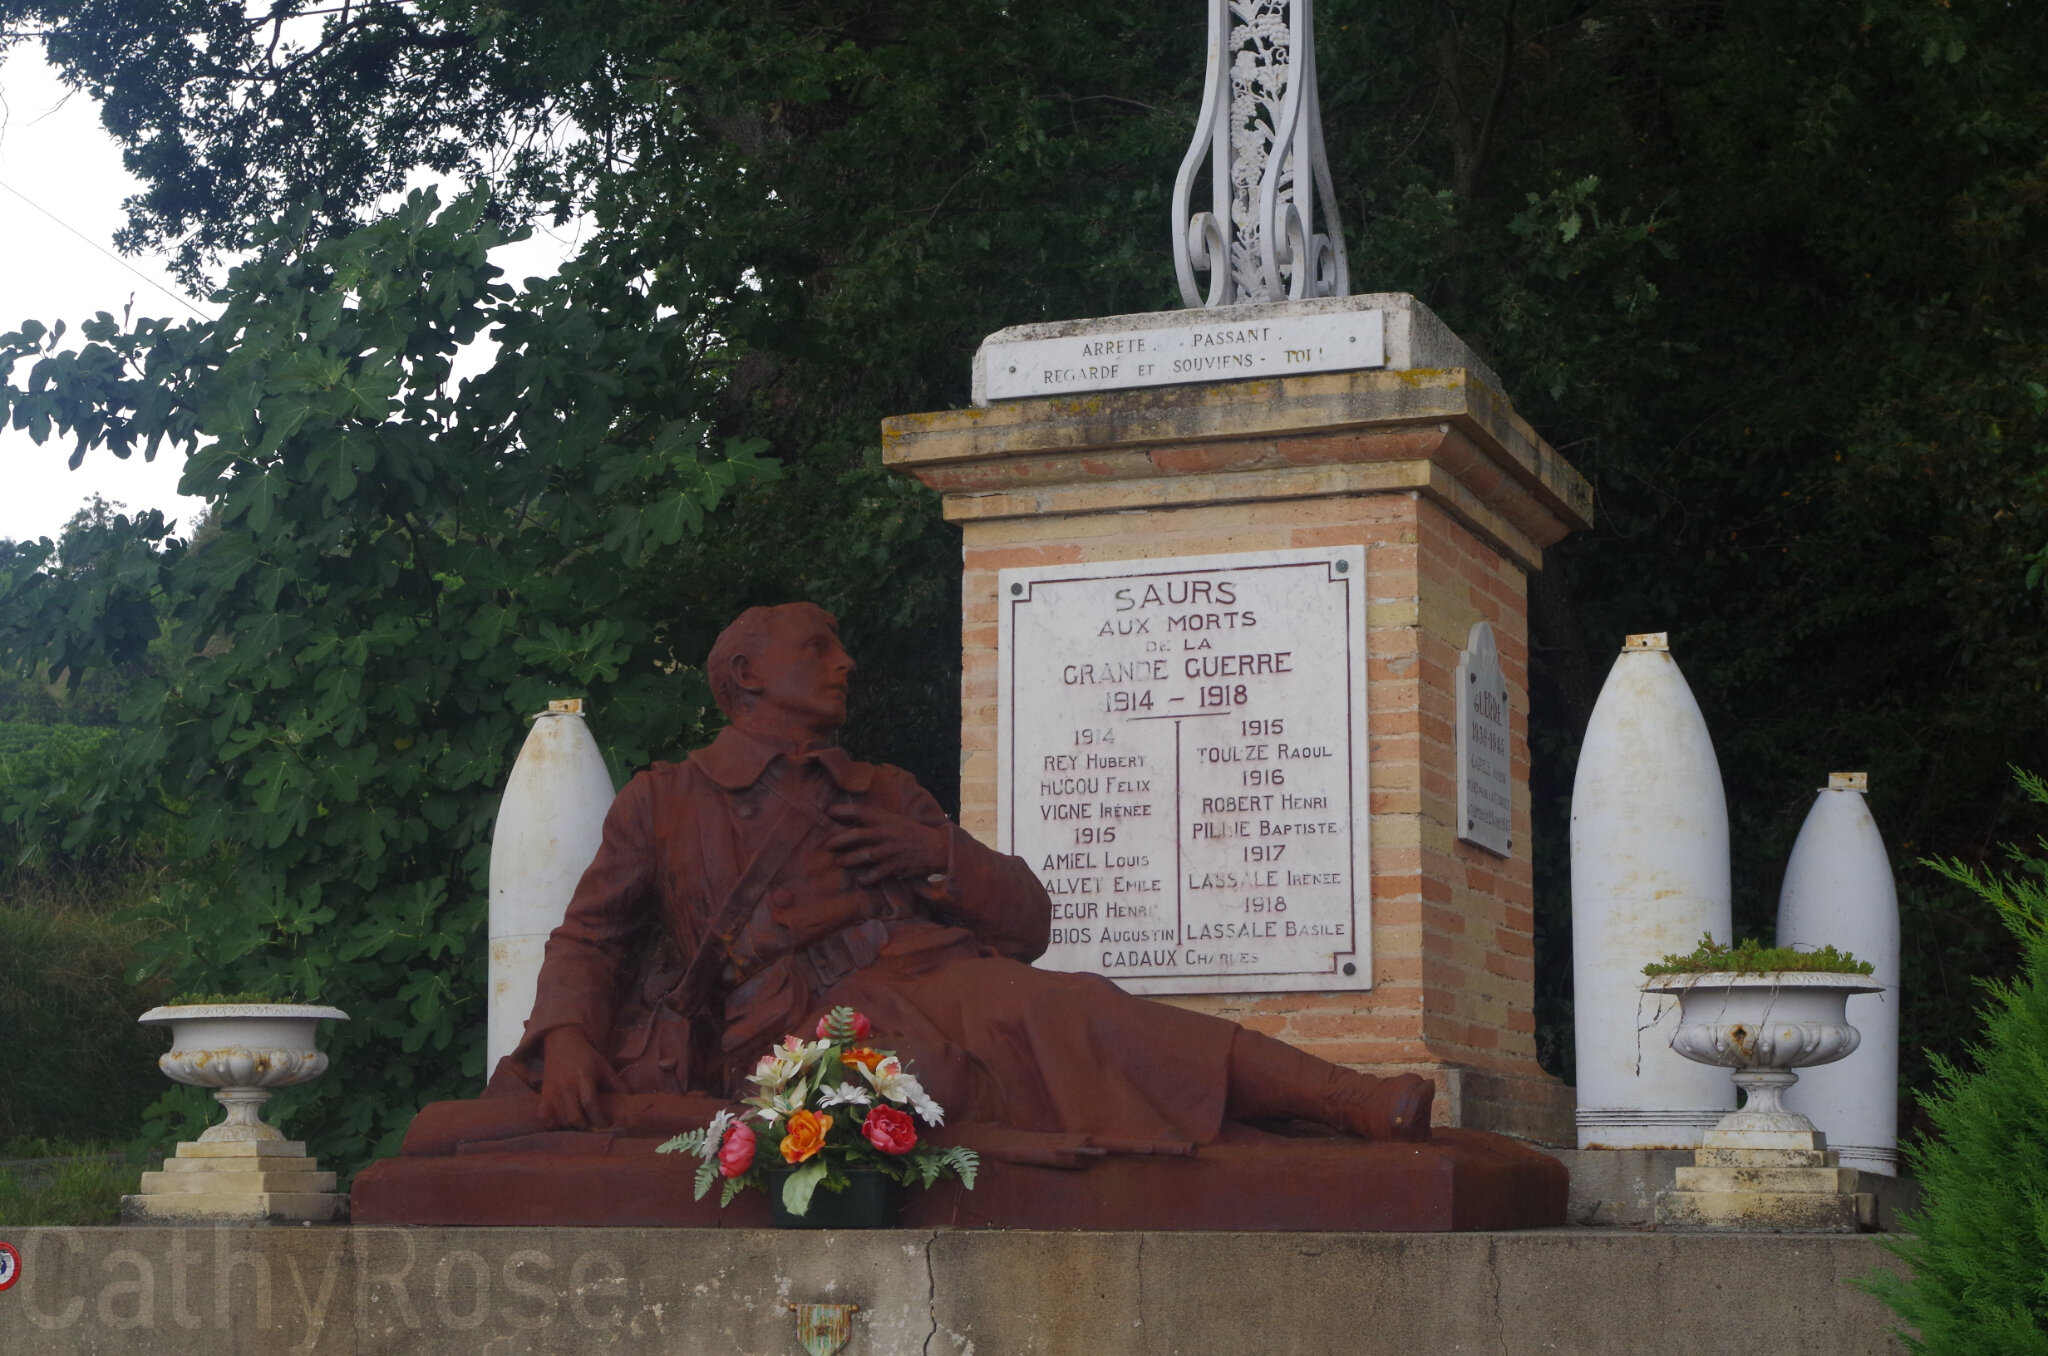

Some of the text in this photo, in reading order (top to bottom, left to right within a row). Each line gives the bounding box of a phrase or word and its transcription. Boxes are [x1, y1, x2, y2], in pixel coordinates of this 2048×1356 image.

[1044, 364, 1120, 384] REGARDE
[1138, 364, 1155, 376] ET
[1115, 580, 1238, 612] SAURS
[1097, 611, 1257, 637] AUX MORTS
[1145, 637, 1212, 653] DE LA
[1063, 651, 1294, 686] GRANDE GUERRE
[1104, 689, 1154, 713] 1914
[1199, 684, 1249, 709] 1918
[1074, 727, 1116, 746] 1914
[1241, 718, 1284, 737] 1915
[1044, 753, 1145, 771] REY HUBERT
[1196, 743, 1333, 764] TOULZE RAOUL
[1106, 776, 1151, 794] FELIX
[1242, 768, 1285, 786] 1916
[1040, 803, 1092, 821] VIGNE
[1202, 793, 1328, 814] ROBERT HENRI
[1075, 826, 1117, 845] 1915
[1260, 820, 1338, 837] BAPTISTE
[1042, 851, 1150, 871] AMIEL LOUIS
[1244, 844, 1286, 863] 1917
[1044, 876, 1161, 895] ALVET EMILE
[1188, 870, 1279, 890] LASSALE
[1051, 902, 1099, 920] EGUR
[1244, 895, 1288, 913] 1918
[1099, 926, 1175, 943] AUGUSTIN
[1186, 920, 1345, 940] LASSALE BASILE
[1102, 949, 1178, 968] CADAUX
